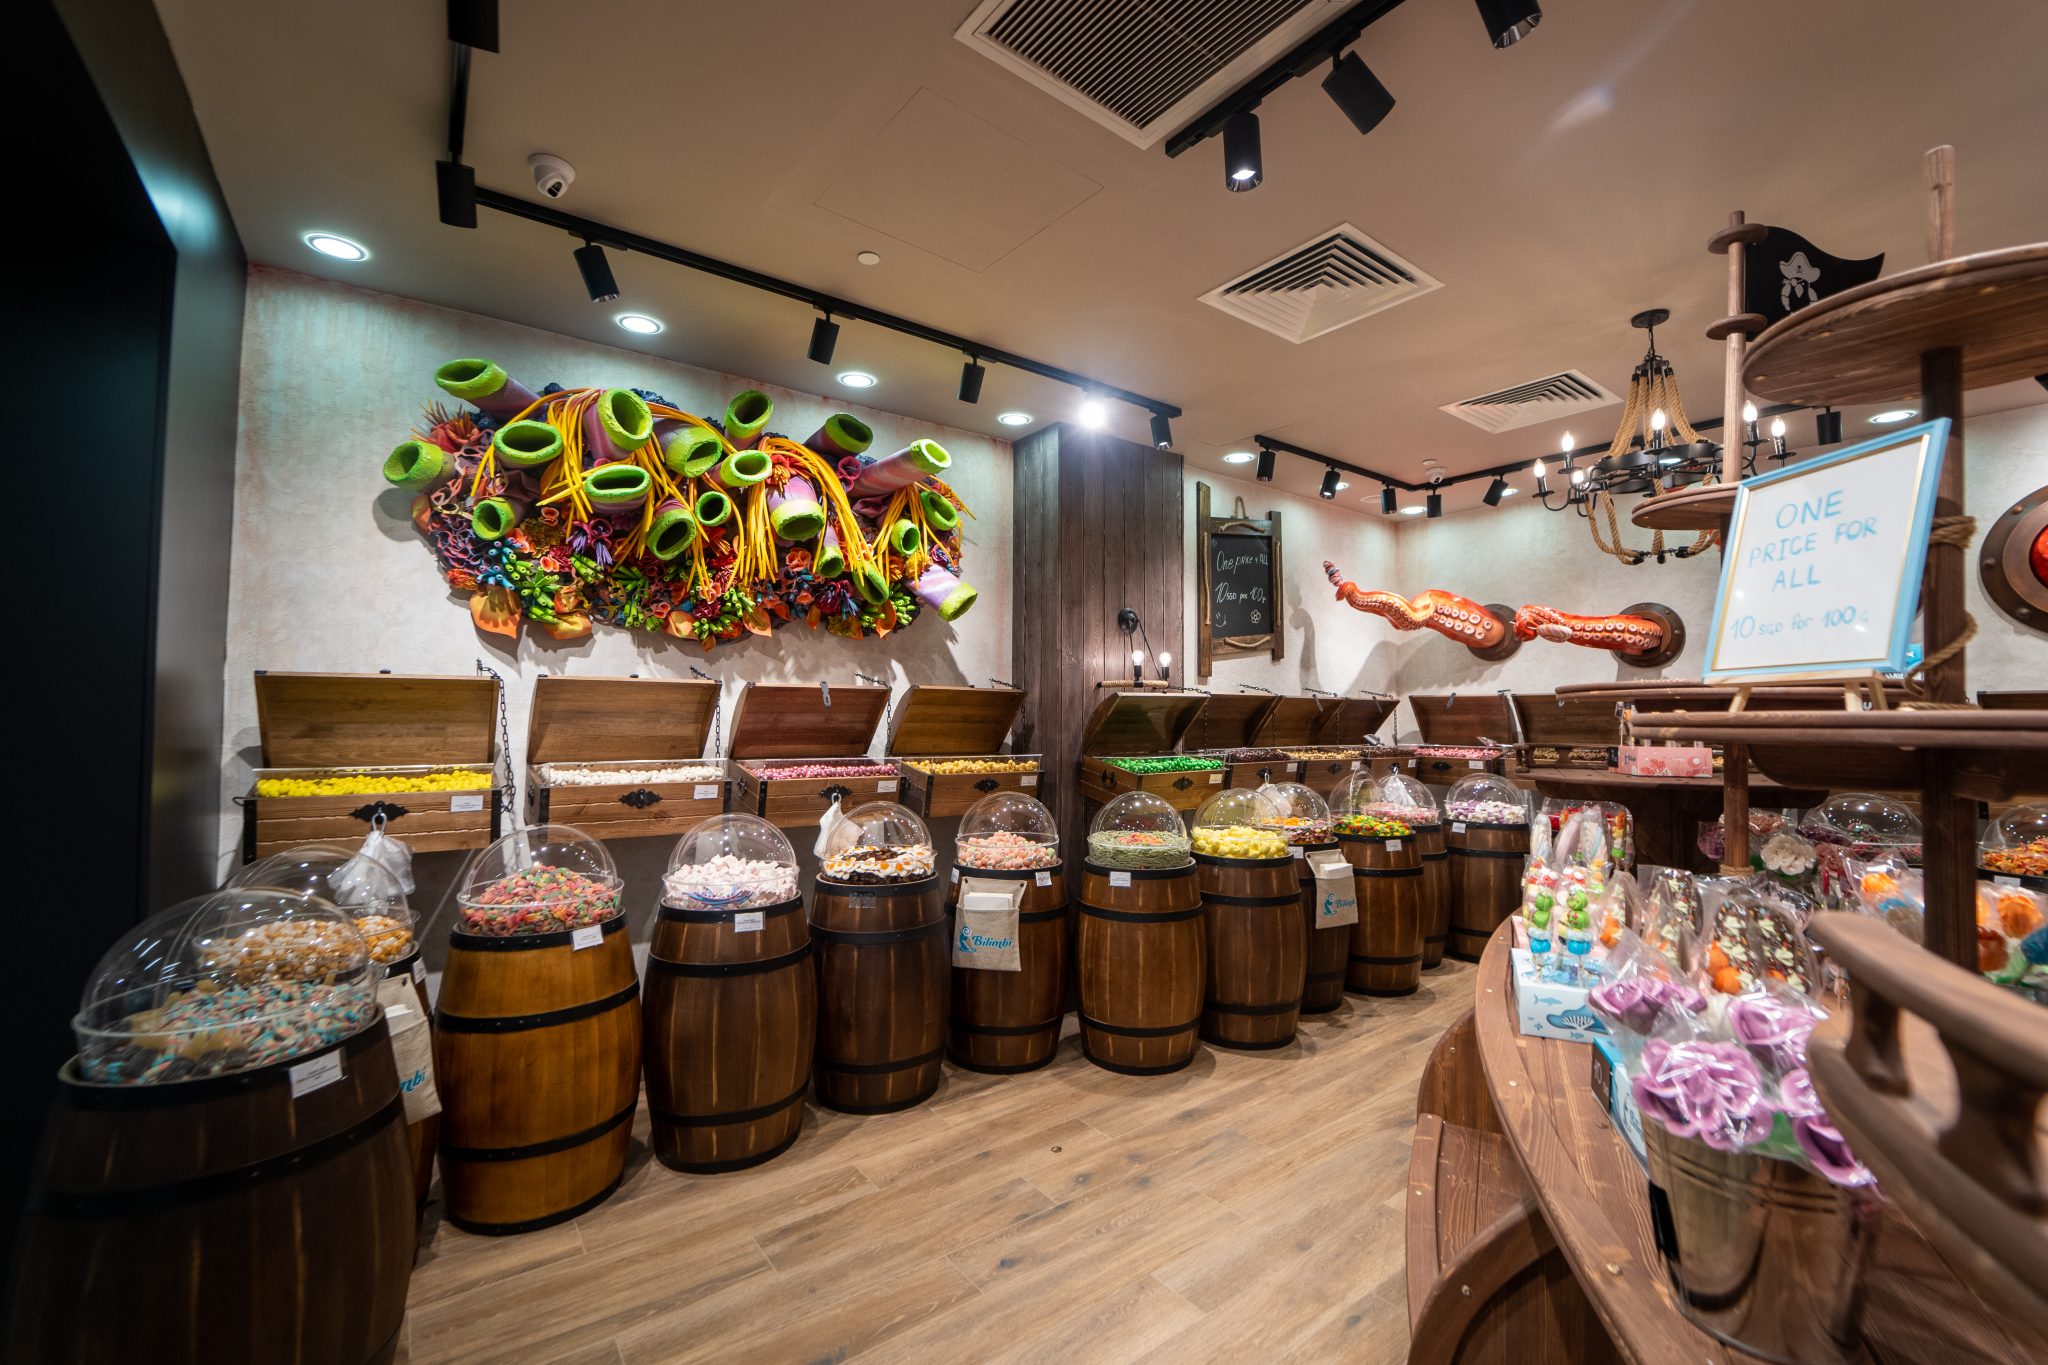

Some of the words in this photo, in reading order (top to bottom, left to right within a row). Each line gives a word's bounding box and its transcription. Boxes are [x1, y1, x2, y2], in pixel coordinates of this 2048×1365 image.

[1776, 490, 1843, 529] ONE
[1749, 532, 1818, 568] PRICE
[1834, 516, 1877, 544] FOR
[1216, 550, 1234, 571] One
[1771, 564, 1821, 592] ALL
[1730, 615, 1756, 639] 10
[1791, 612, 1813, 630] for
[1823, 605, 1857, 628] 100
[972, 935, 1013, 949] Bilimbi
